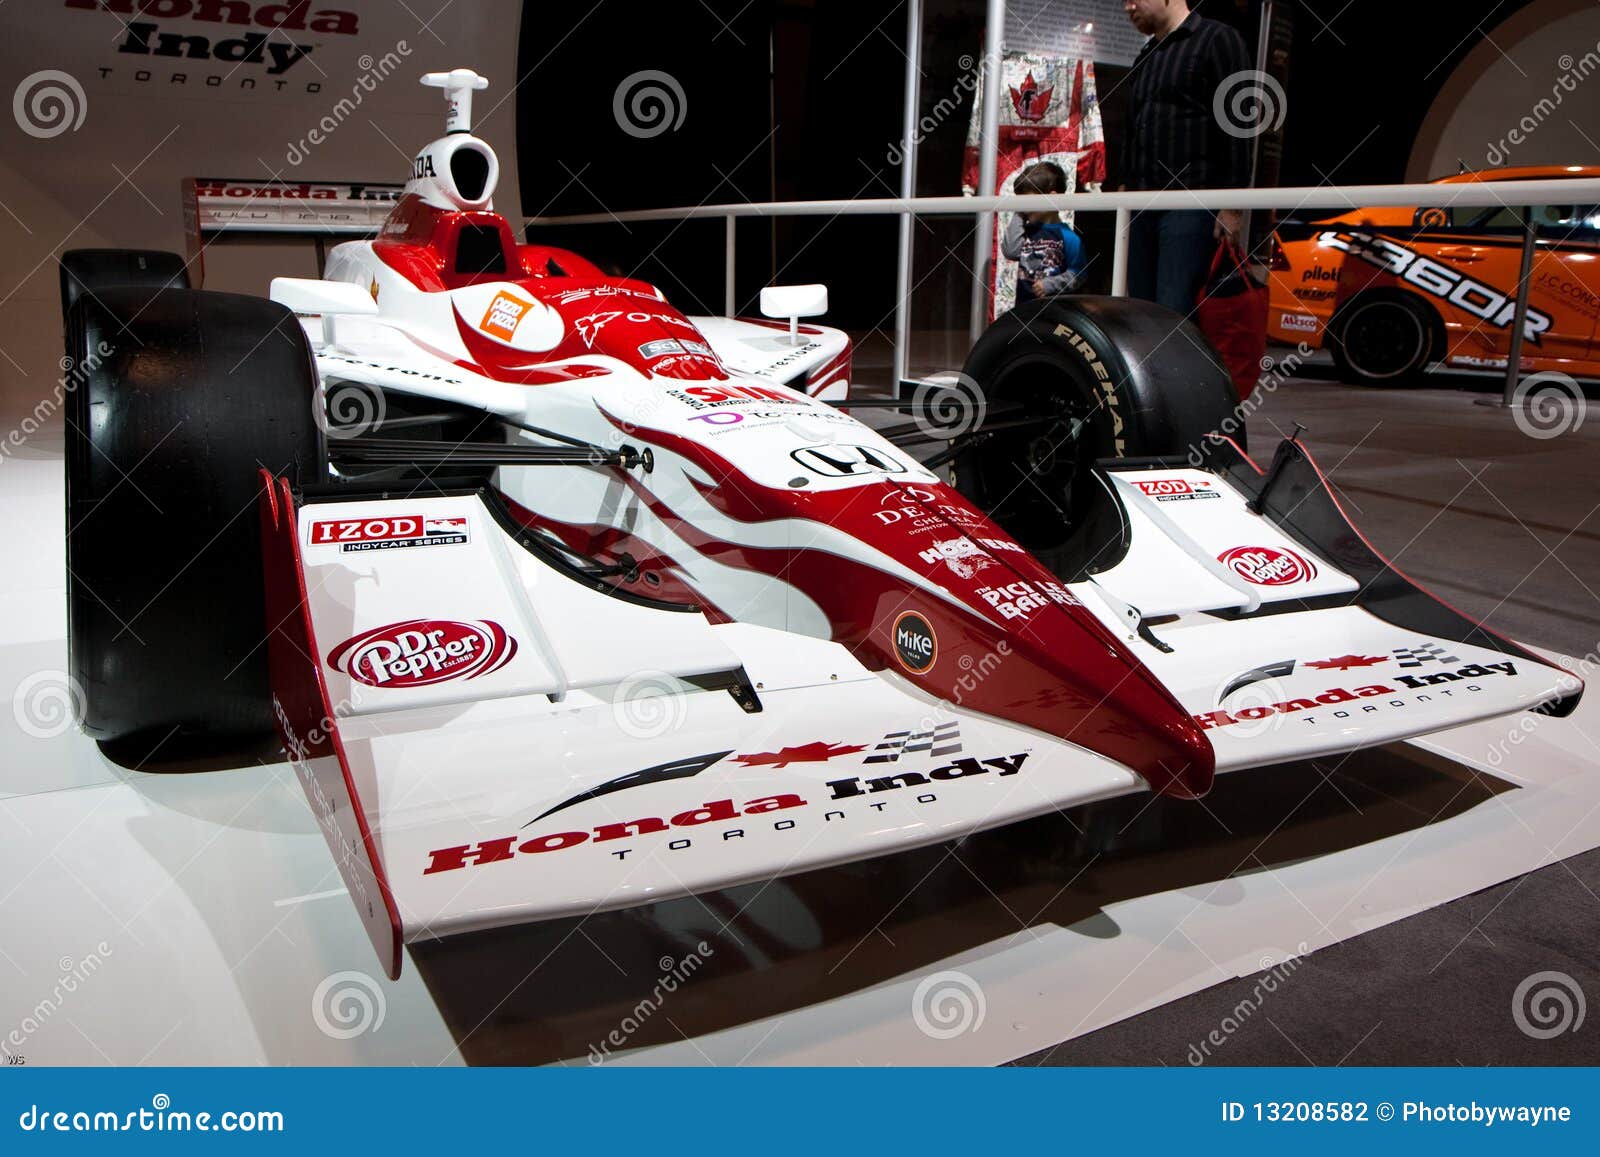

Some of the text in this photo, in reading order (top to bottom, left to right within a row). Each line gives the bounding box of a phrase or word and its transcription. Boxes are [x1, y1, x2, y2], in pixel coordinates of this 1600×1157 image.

[118, 22, 314, 75] Indy
[99, 67, 321, 93] TORONTO
[195, 182, 402, 201] Honda In
[1053, 323, 1124, 458] FIREHA
[1139, 480, 1188, 495] ZOD
[872, 504, 980, 526] DETA
[908, 521, 950, 536] DOWNTOW
[913, 515, 973, 528] CHESEA
[320, 518, 417, 541] IZOD
[348, 536, 463, 551] INDYCAR SERIES
[918, 537, 1026, 565] HOOERS
[396, 629, 445, 656] Dr
[352, 634, 481, 684] Pepper
[1192, 661, 1518, 731] Honda Indy
[1303, 685, 1482, 725] TORONTO
[423, 752, 1029, 876] Honda Indy
[611, 793, 937, 860] TORONTO
